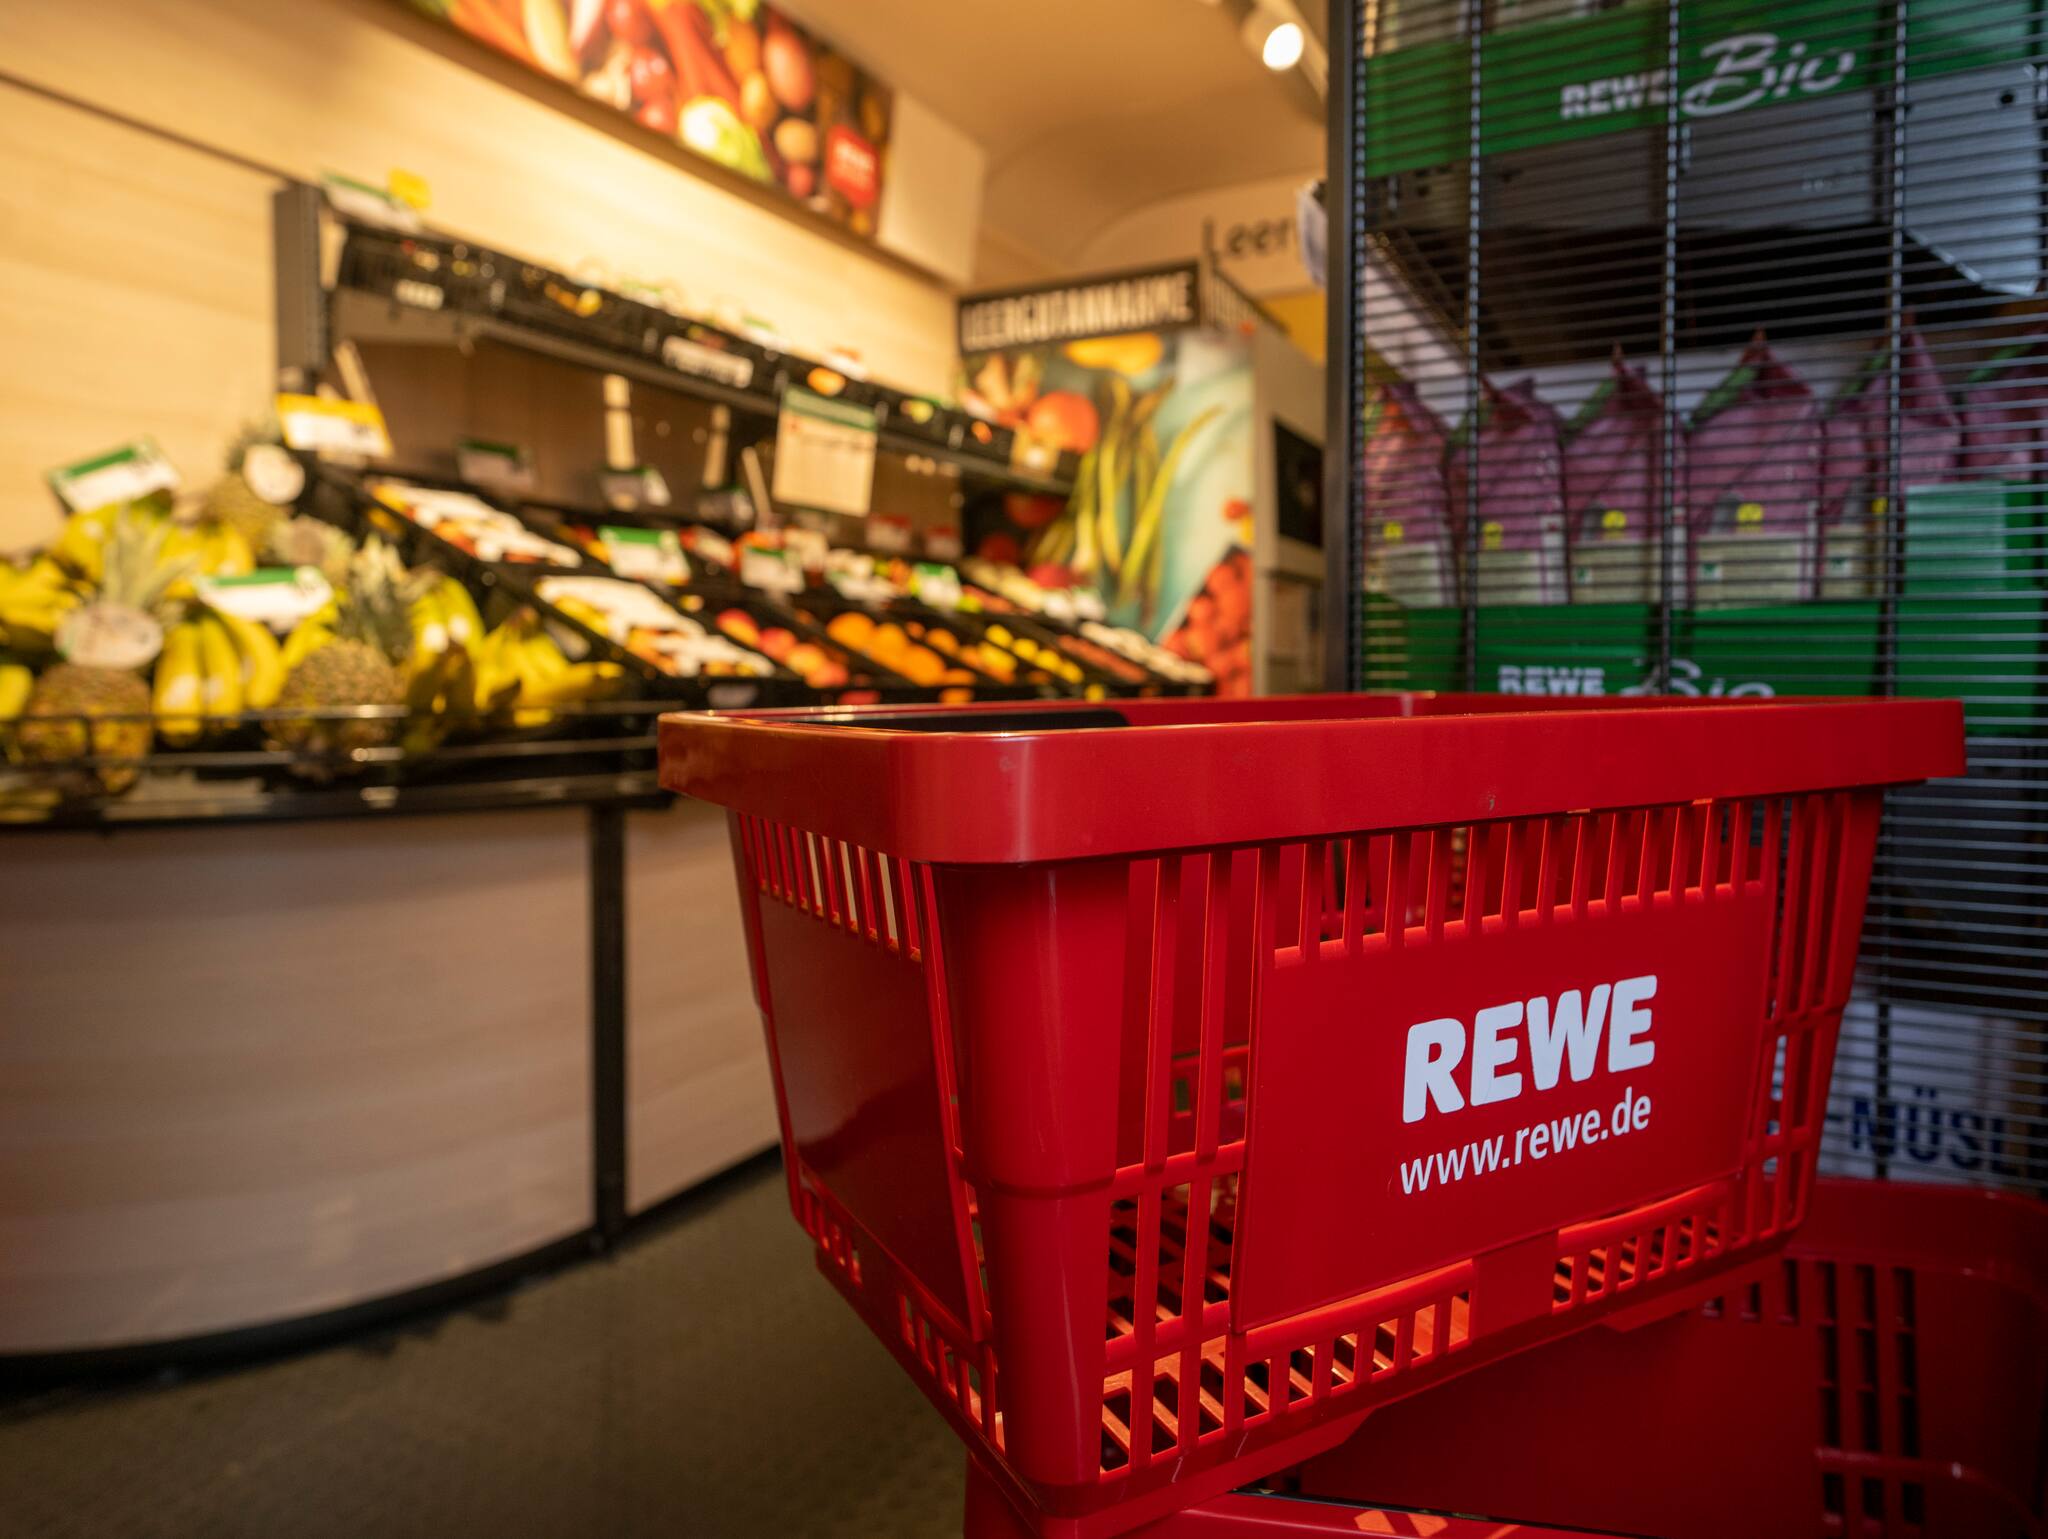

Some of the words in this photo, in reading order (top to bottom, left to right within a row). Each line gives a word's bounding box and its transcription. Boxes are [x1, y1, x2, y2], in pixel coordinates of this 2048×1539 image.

[1561, 69, 1672, 119] REWE
[1681, 32, 1856, 117] Bio
[1498, 665, 1605, 697] REWE
[1403, 974, 1658, 1124] REWE
[1400, 1086, 1652, 1195] www.rewe.de
